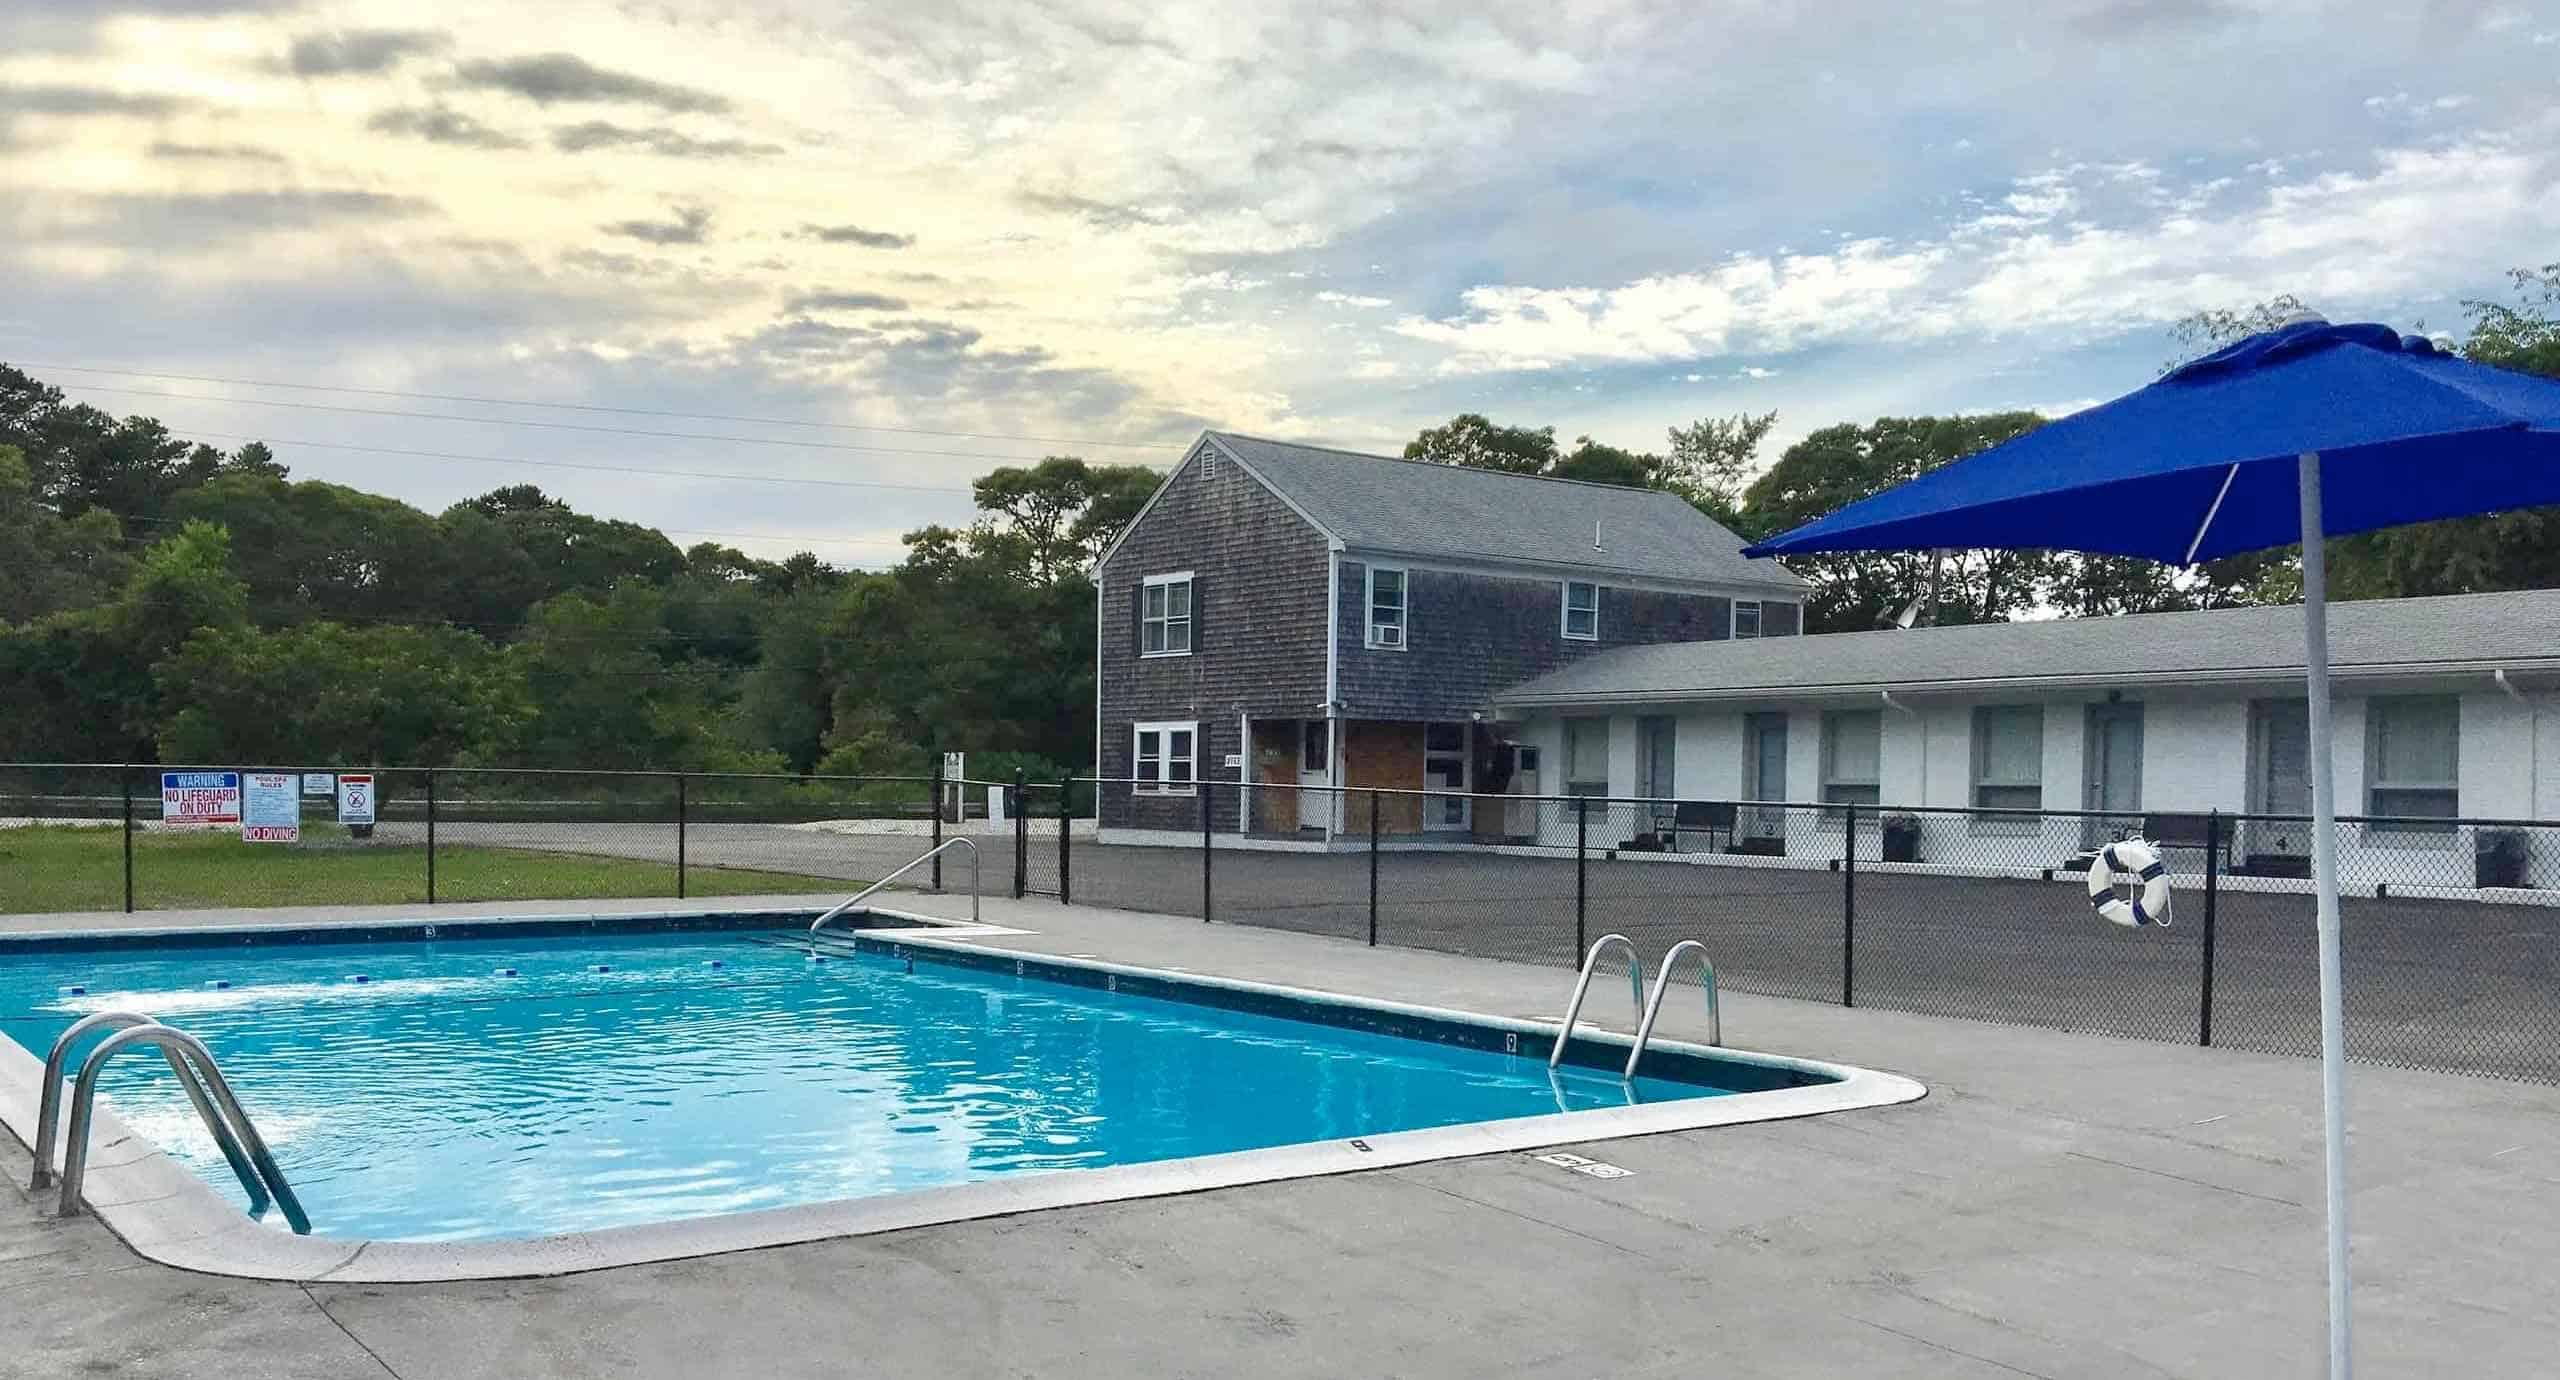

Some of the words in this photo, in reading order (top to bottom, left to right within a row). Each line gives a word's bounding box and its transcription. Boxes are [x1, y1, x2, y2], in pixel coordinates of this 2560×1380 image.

[178, 775, 225, 787] WARNING
[165, 790, 178, 802] NO
[182, 789, 236, 801] LIFEGUARD
[180, 803, 193, 814] ON
[198, 802, 222, 814] DUTY
[245, 828, 259, 839] NO
[262, 828, 296, 839] DIVING
